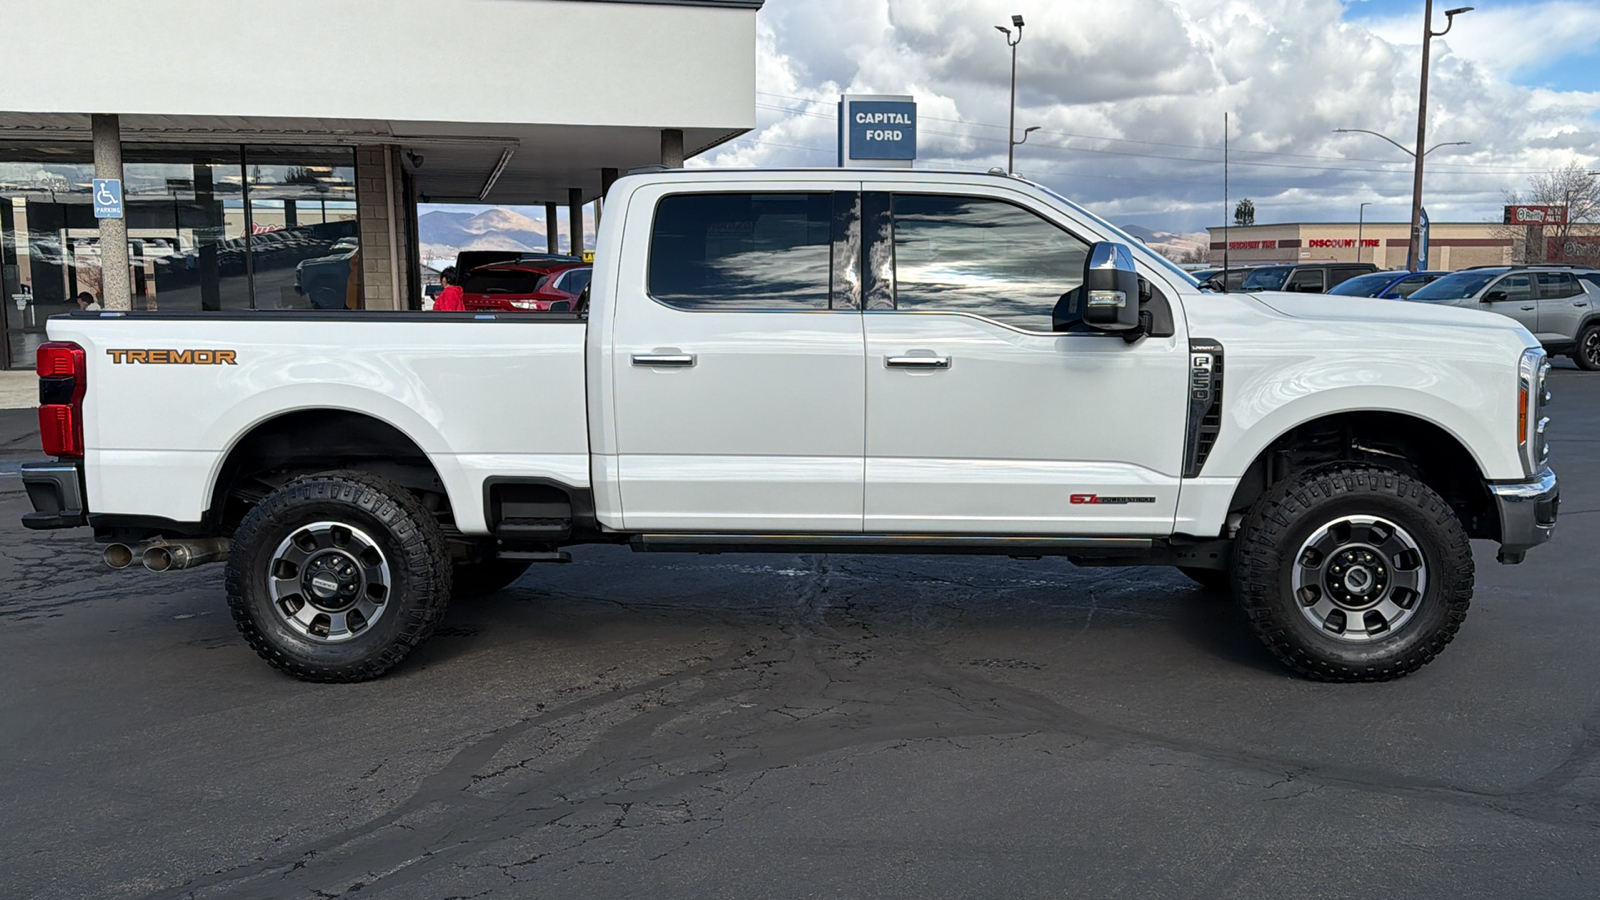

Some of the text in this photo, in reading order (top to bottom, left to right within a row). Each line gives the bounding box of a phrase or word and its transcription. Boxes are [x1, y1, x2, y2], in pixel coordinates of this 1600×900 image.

[855, 112, 912, 125] CAPITAL
[866, 130, 902, 141] FORD
[1228, 240, 1277, 249] DISCOUNT TIRE
[1308, 239, 1380, 248] DISCOUNT TIRE
[106, 348, 238, 365] TREMOR
